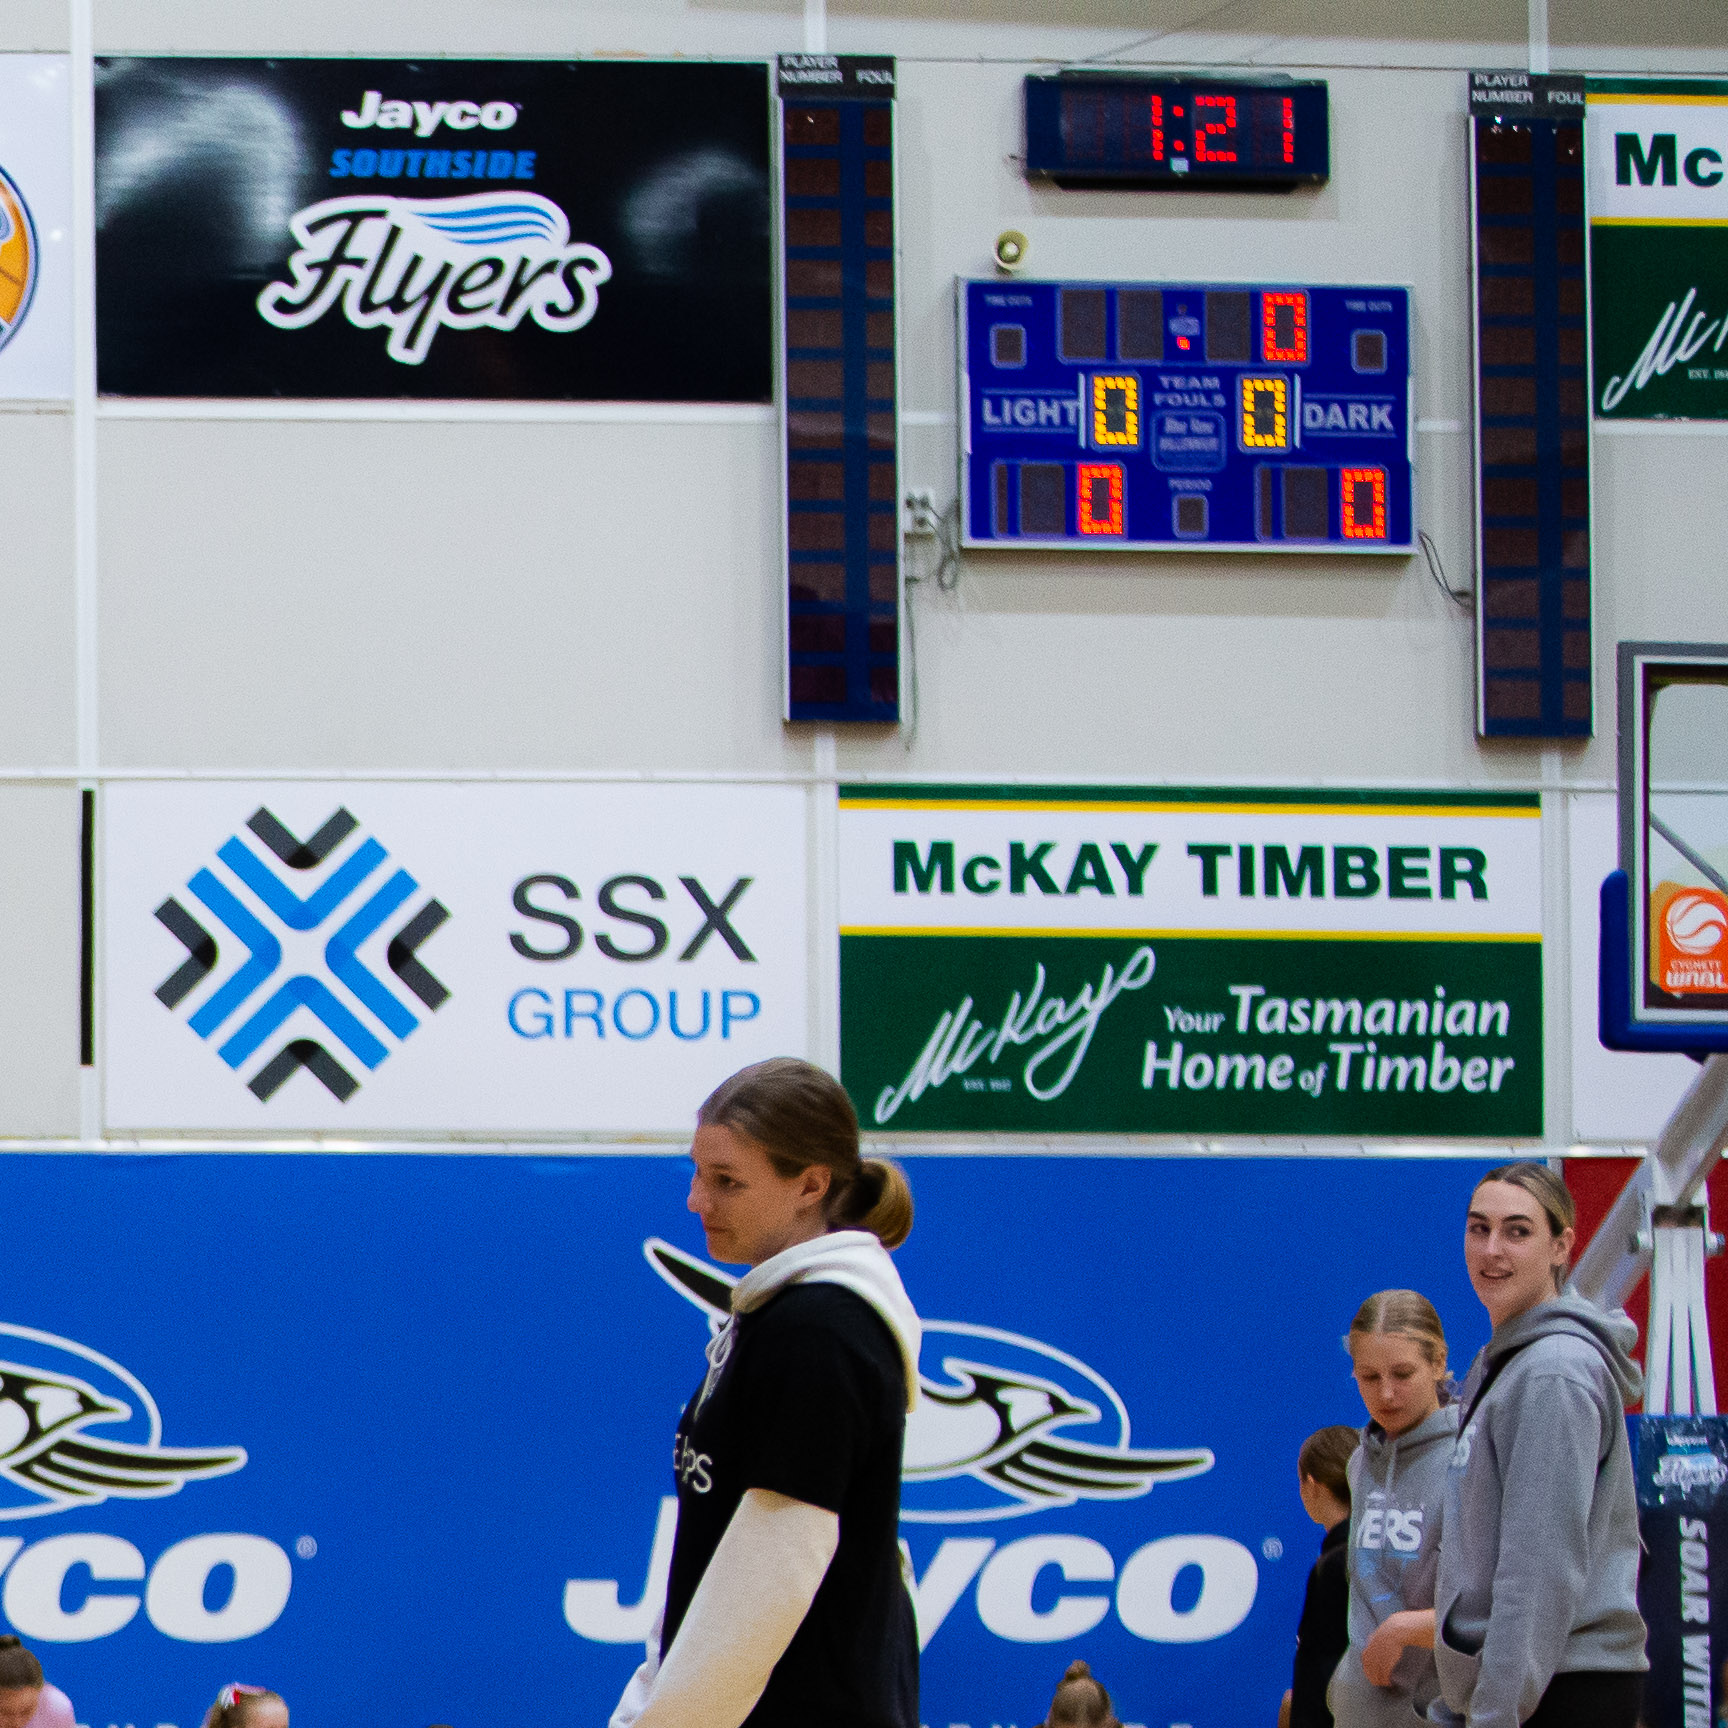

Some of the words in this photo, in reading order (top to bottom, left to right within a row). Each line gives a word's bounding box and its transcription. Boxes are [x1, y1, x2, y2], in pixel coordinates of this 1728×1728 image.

[341, 90, 518, 137] Jayco
[1152, 96, 1294, 163] 1:21
[329, 149, 537, 179] SOUTHSIDE
[1614, 132, 1725, 187] Mc
[266, 203, 606, 357] Flyers
[1263, 292, 1307, 362] 0
[983, 399, 1081, 425] LIGHT
[1093, 376, 1138, 446] 0
[1152, 392, 1227, 408] FOULS
[1158, 376, 1221, 390] TEAM
[1242, 379, 1287, 449] 0
[1304, 403, 1394, 431] DARK
[1077, 463, 1124, 536] 0
[1342, 468, 1387, 540] 0
[892, 840, 1160, 896] McKAY
[1187, 842, 1490, 901] TIMBER
[508, 873, 758, 963] SSX
[508, 987, 761, 1040] GROUP
[1163, 1004, 1226, 1033] Your
[1228, 984, 1510, 1036] Tasmanian
[1142, 1040, 1294, 1090] Home
[1299, 1061, 1329, 1098] of
[1328, 1040, 1516, 1092] Timber
[1680, 1514, 1710, 1625] SOAR
